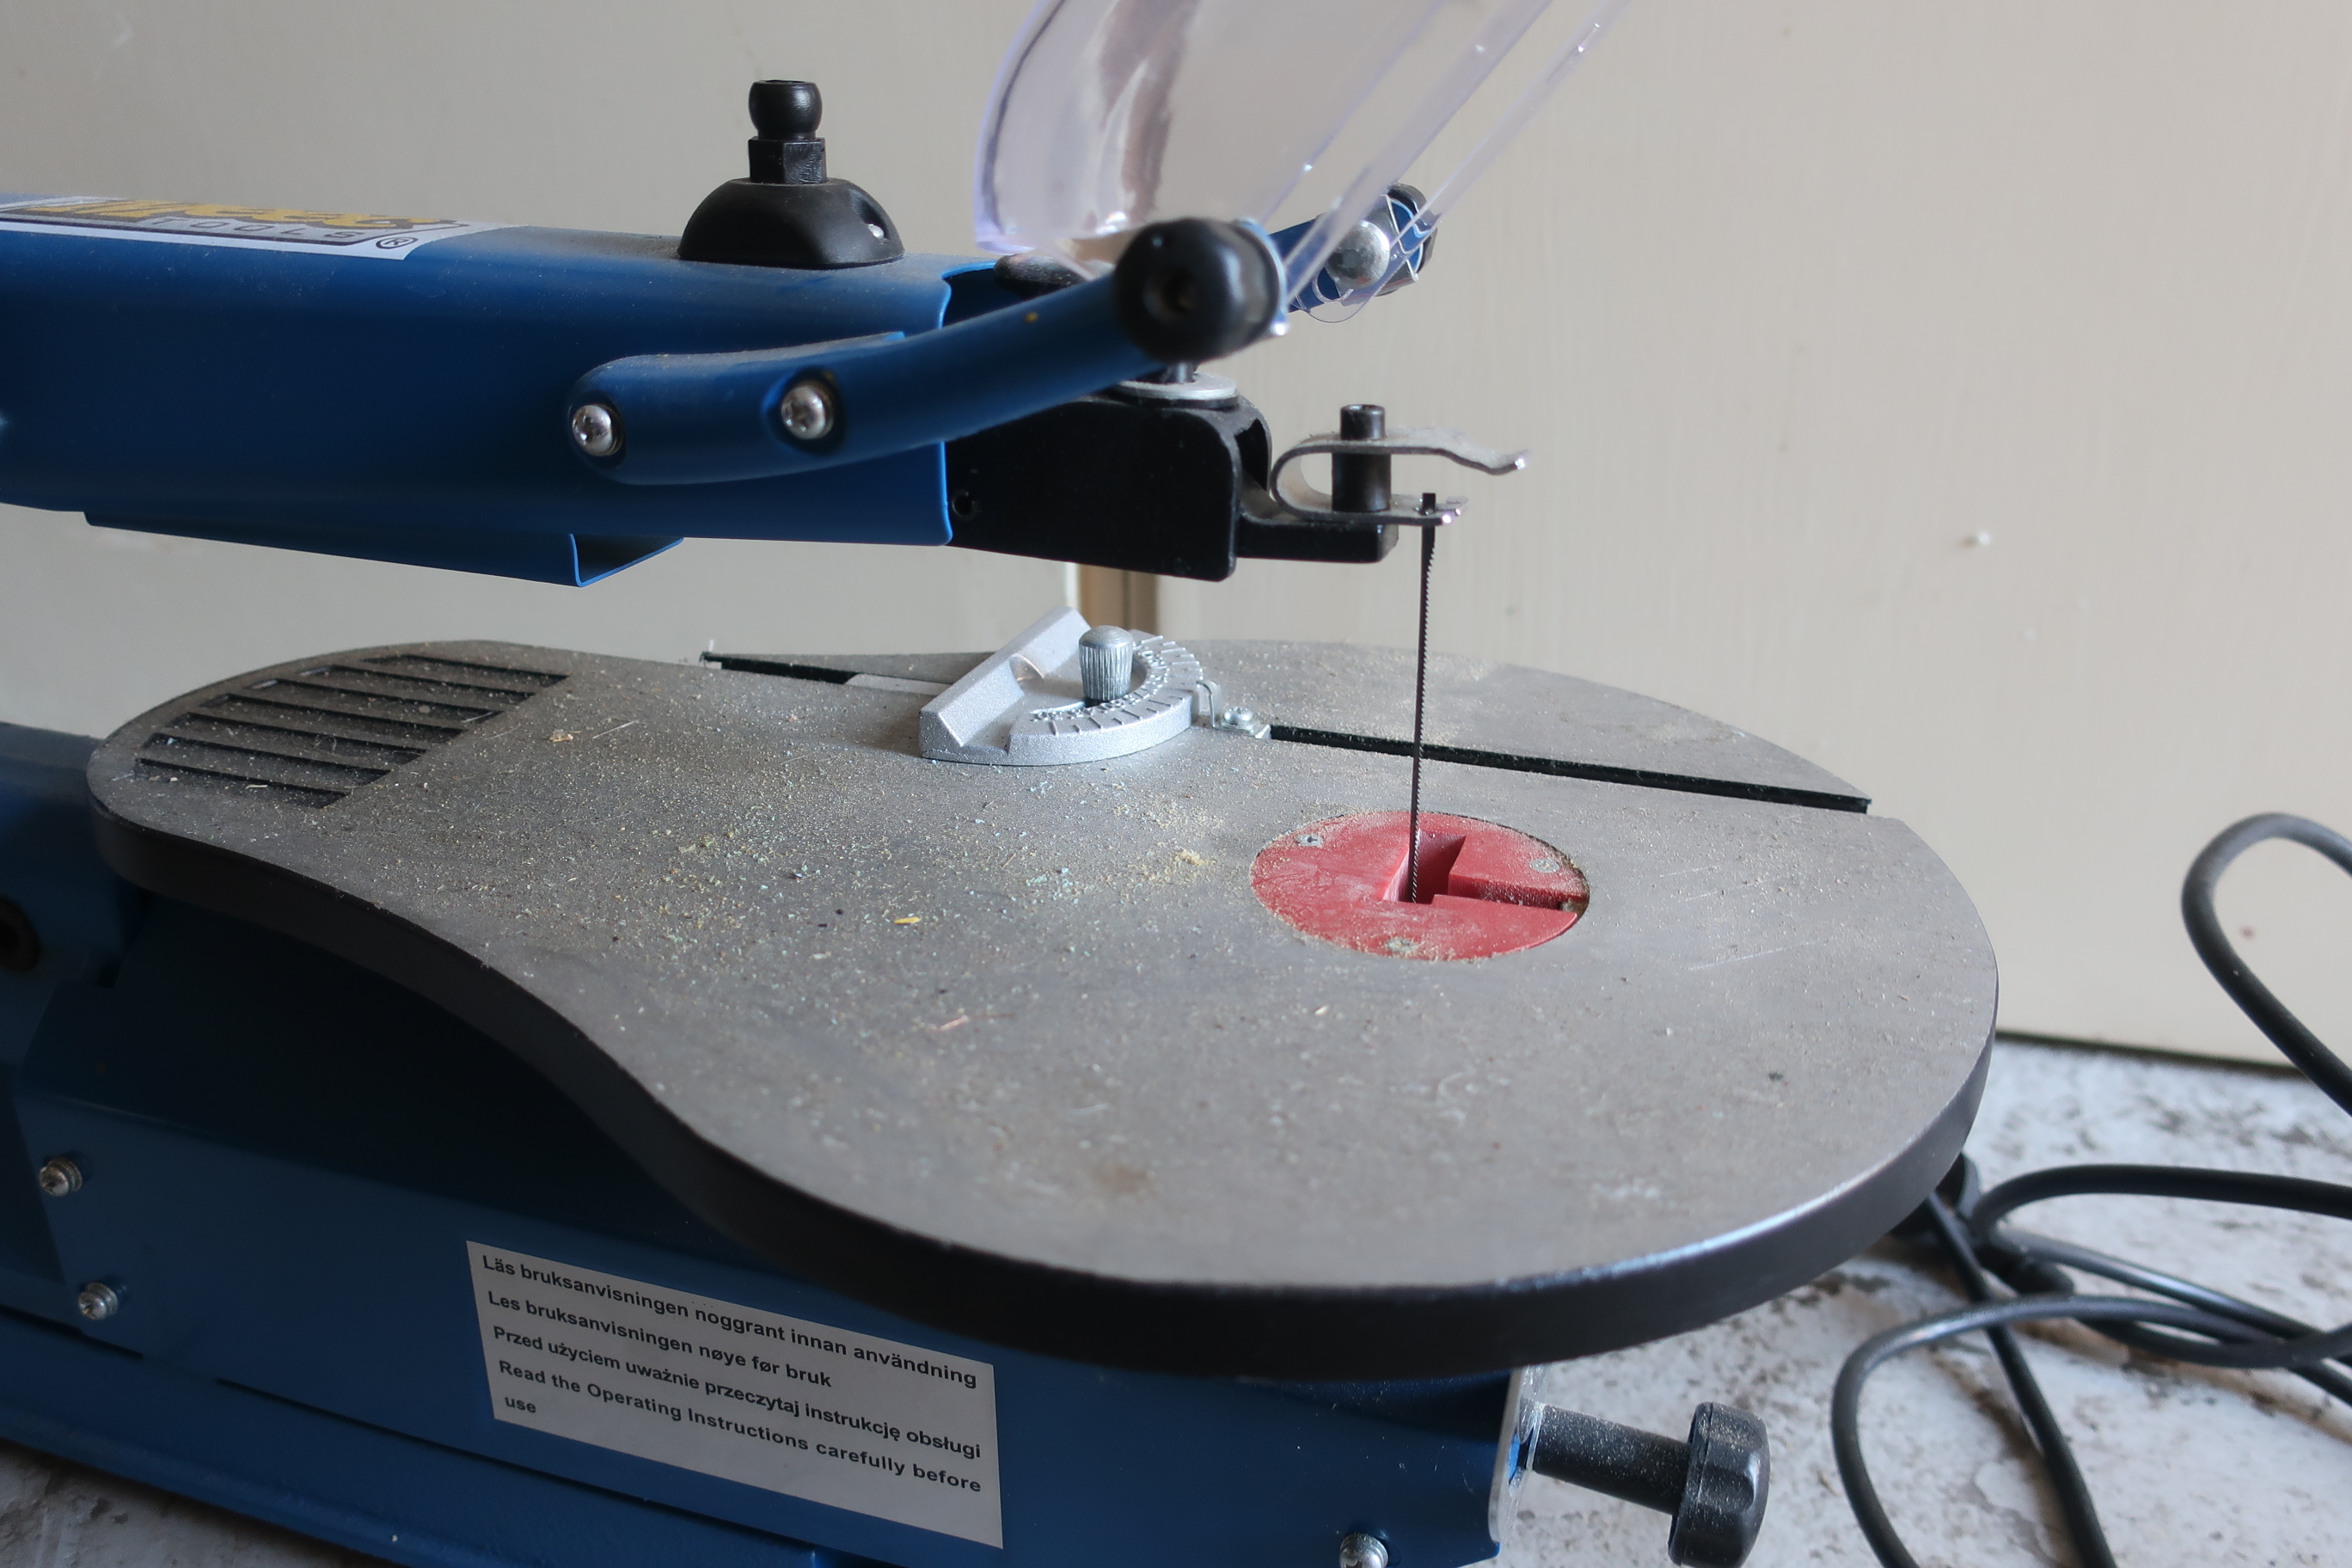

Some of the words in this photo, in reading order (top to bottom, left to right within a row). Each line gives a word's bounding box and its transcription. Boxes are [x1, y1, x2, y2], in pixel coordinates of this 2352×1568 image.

[152, 217, 364, 239] TOOLS
[483, 1255, 515, 1276] Läs
[521, 1265, 689, 1318] bruksanvisningen
[695, 1309, 786, 1341] noggrant
[792, 1330, 847, 1356] innan
[854, 1347, 977, 1389] användning
[488, 1290, 521, 1311] Les
[526, 1301, 692, 1354] bruksanvisningen
[699, 1345, 746, 1367] nøye
[751, 1356, 781, 1374] før
[786, 1364, 832, 1387] bruk
[493, 1326, 542, 1351] Przed
[548, 1341, 621, 1370] użyciem
[626, 1363, 700, 1389] uważnie
[705, 1381, 800, 1418] przeczytaj
[805, 1402, 901, 1442] instrukcję
[907, 1430, 981, 1460] obsługi
[499, 1360, 546, 1384] Read
[551, 1374, 581, 1393] the
[587, 1383, 682, 1422] Operating
[689, 1407, 809, 1455] Instructions
[817, 1443, 905, 1477] carefully
[913, 1463, 982, 1492] before
[505, 1396, 536, 1414] use
